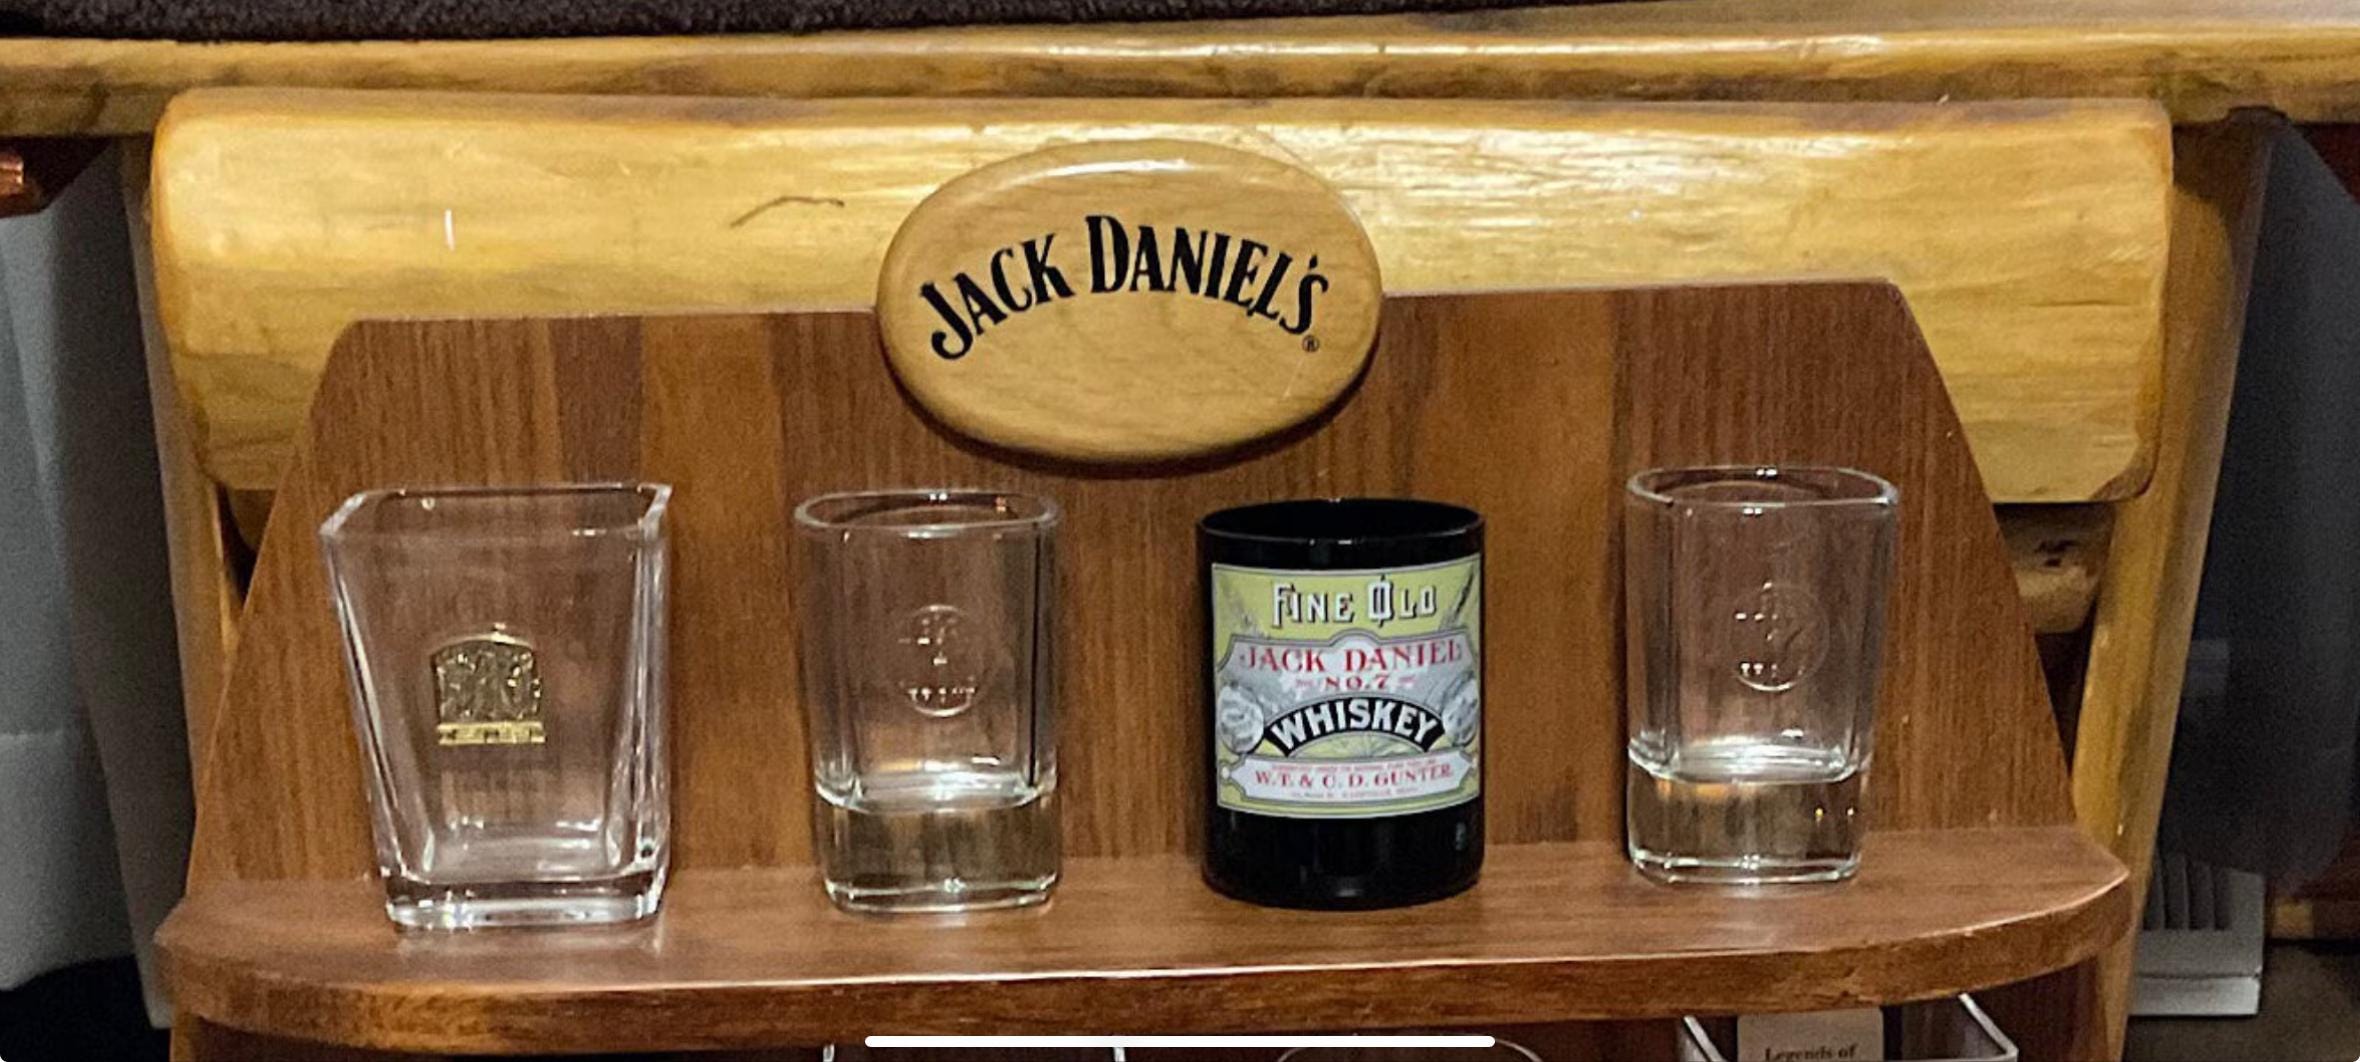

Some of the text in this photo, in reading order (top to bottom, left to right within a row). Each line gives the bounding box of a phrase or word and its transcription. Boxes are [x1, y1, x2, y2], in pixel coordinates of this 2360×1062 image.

[920, 214, 1329, 361] JACK DANIEL'S
[1271, 574, 1438, 629] FINE OLD
[1247, 638, 1462, 673] JACK DANIEL
[1271, 698, 1439, 751] WHISKEY
[1374, 763, 1455, 786] GUNTER
[1838, 1043, 1859, 1059] of
